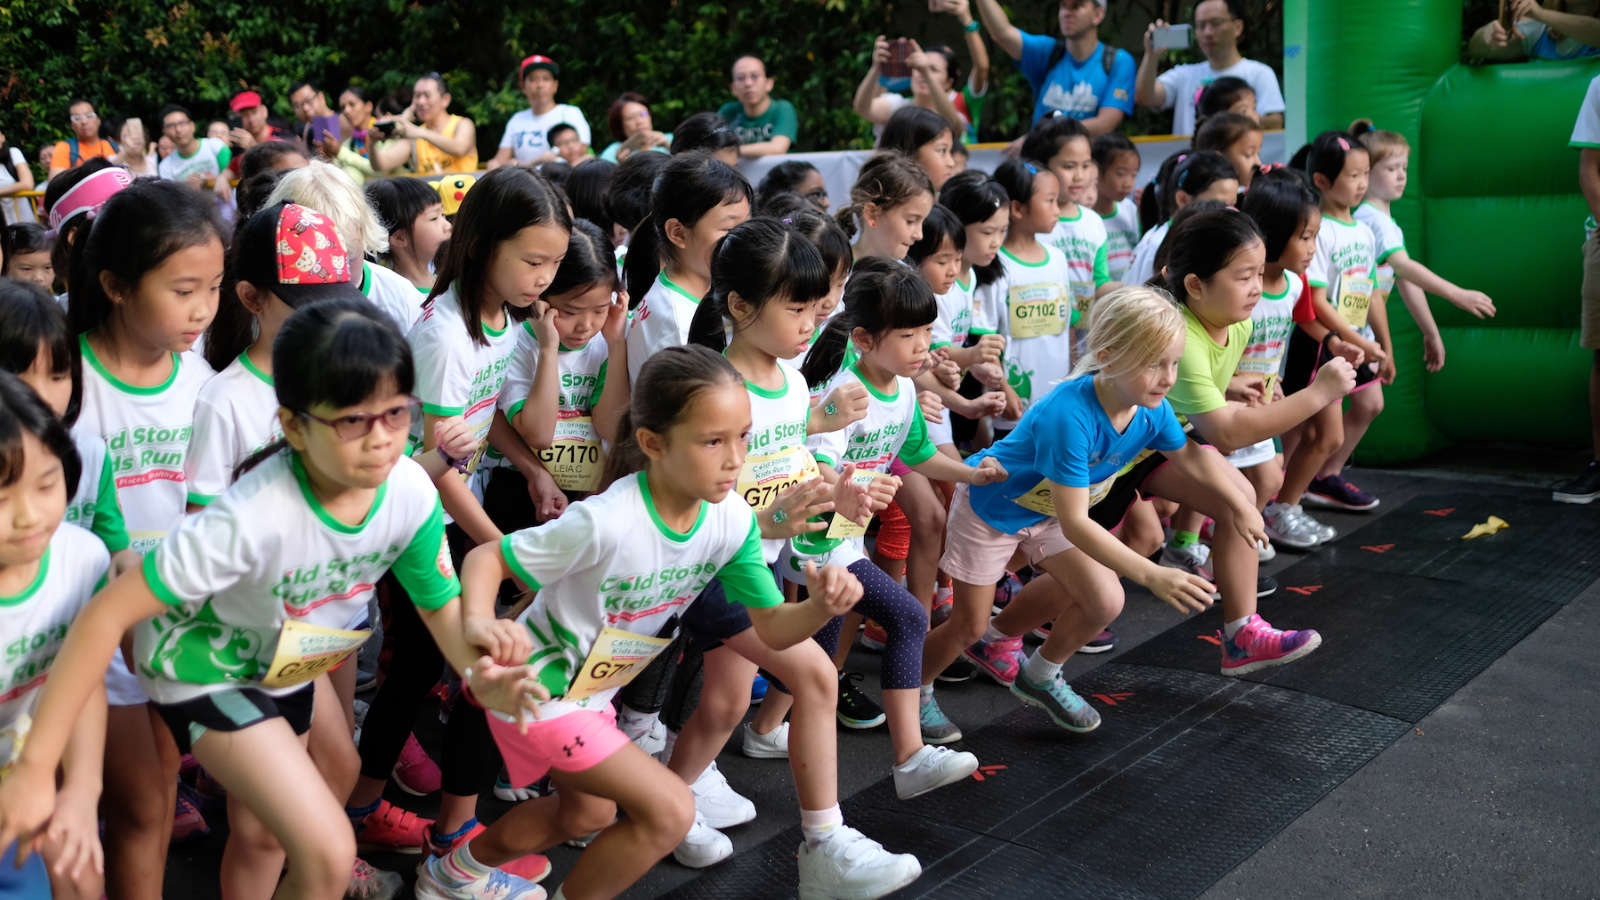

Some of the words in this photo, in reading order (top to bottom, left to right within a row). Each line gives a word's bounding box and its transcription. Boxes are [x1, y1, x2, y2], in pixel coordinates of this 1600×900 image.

[1016, 303, 1056, 318] G7102
[140, 449, 183, 468] Run
[538, 444, 599, 464] G7170
[843, 446, 880, 461] Kids
[600, 572, 655, 593] Cold
[604, 594, 653, 610] Kids
